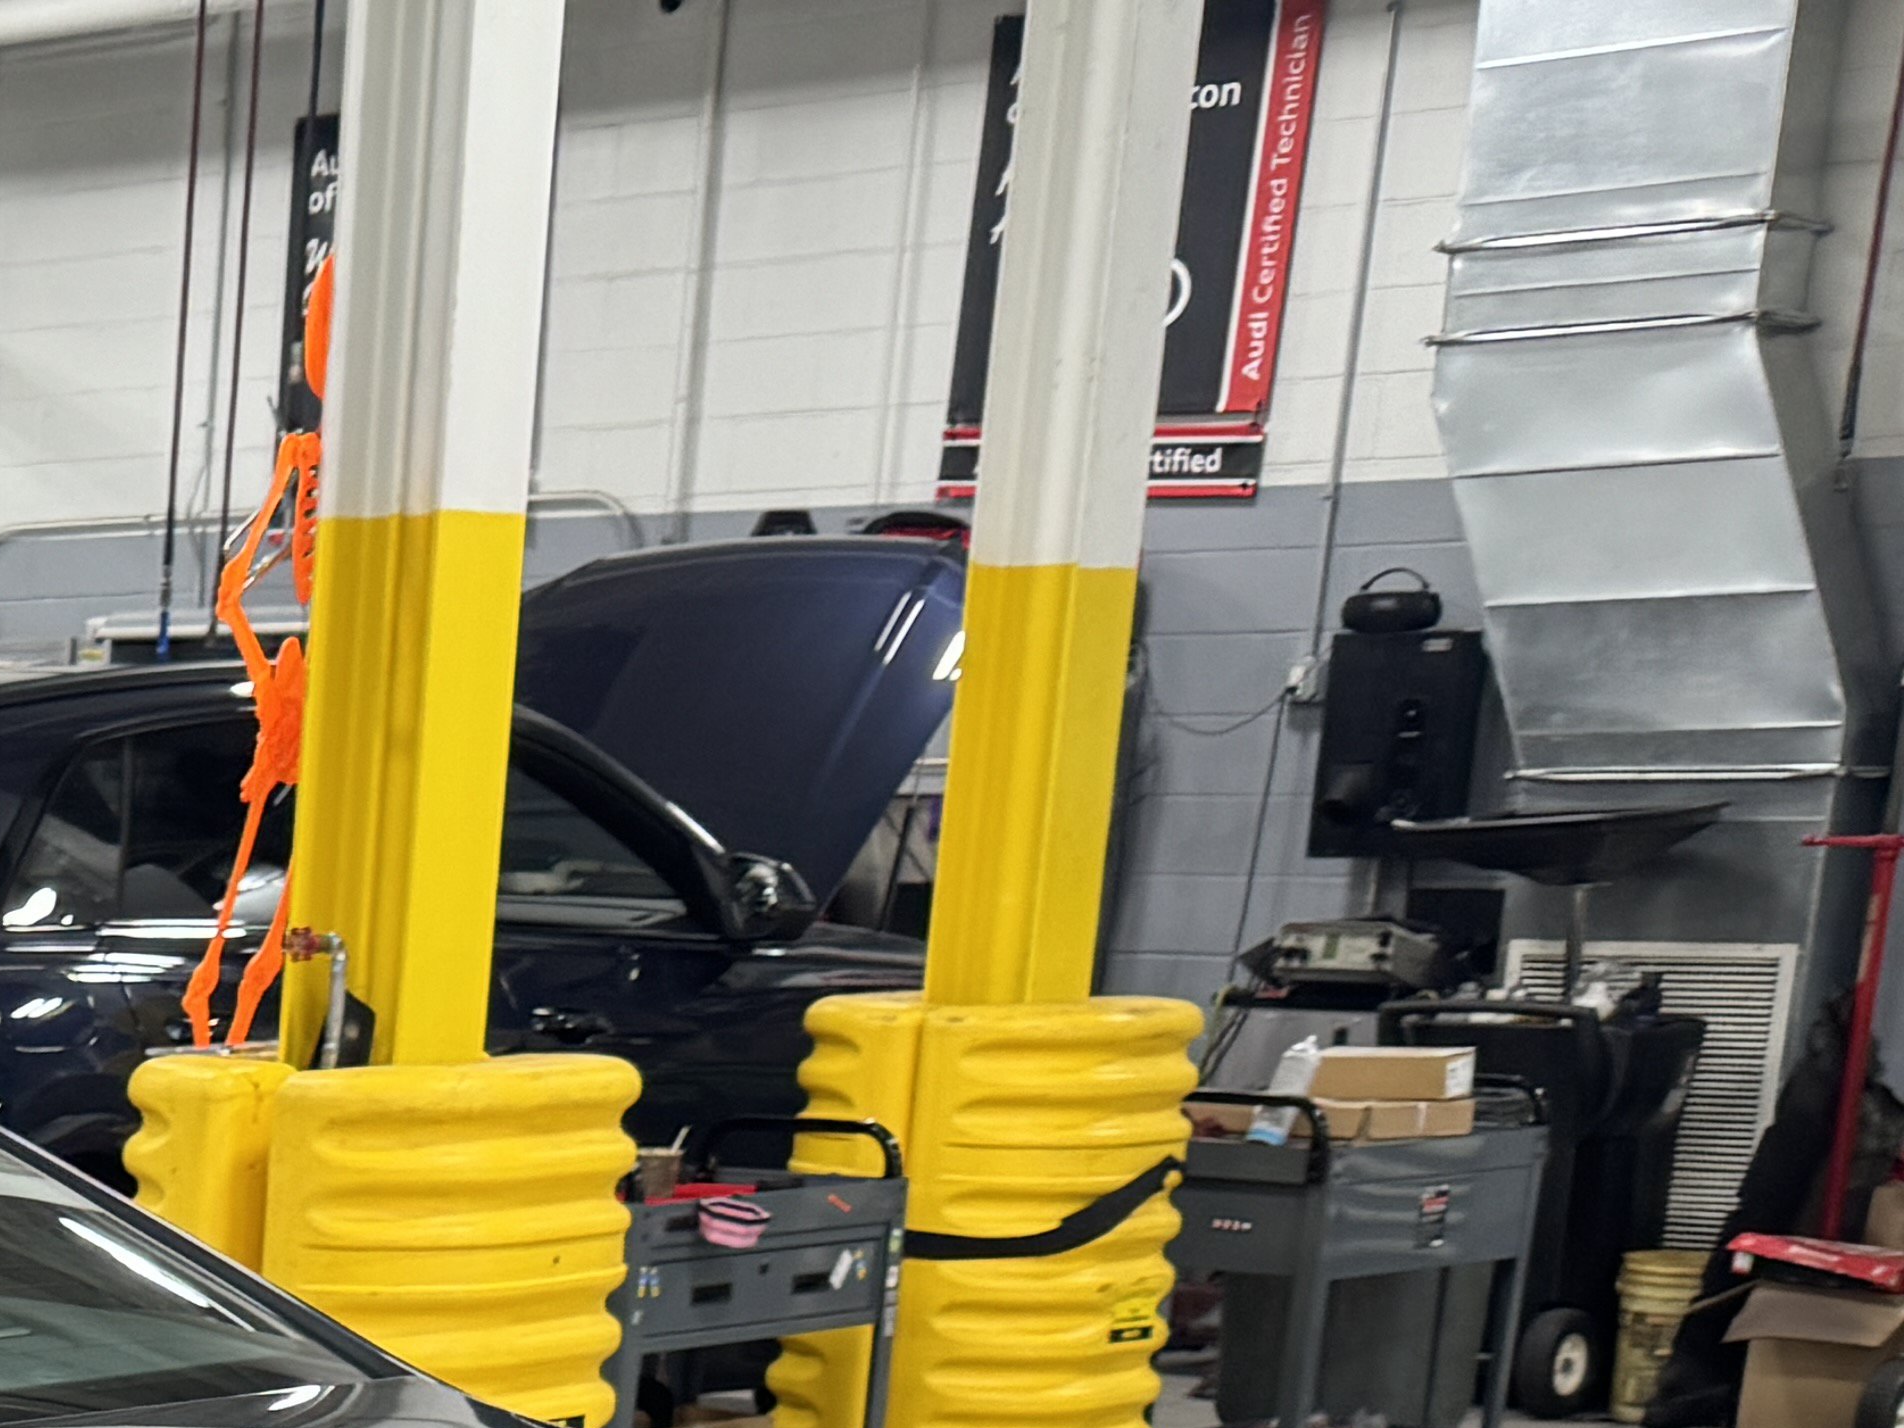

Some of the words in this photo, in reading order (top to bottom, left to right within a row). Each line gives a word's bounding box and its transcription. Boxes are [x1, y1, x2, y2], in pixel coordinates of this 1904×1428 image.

[1269, 13, 1313, 172] Technician
[1251, 176, 1289, 304] Certified
[1240, 311, 1269, 381] Audi
[1149, 446, 1223, 474] tified
